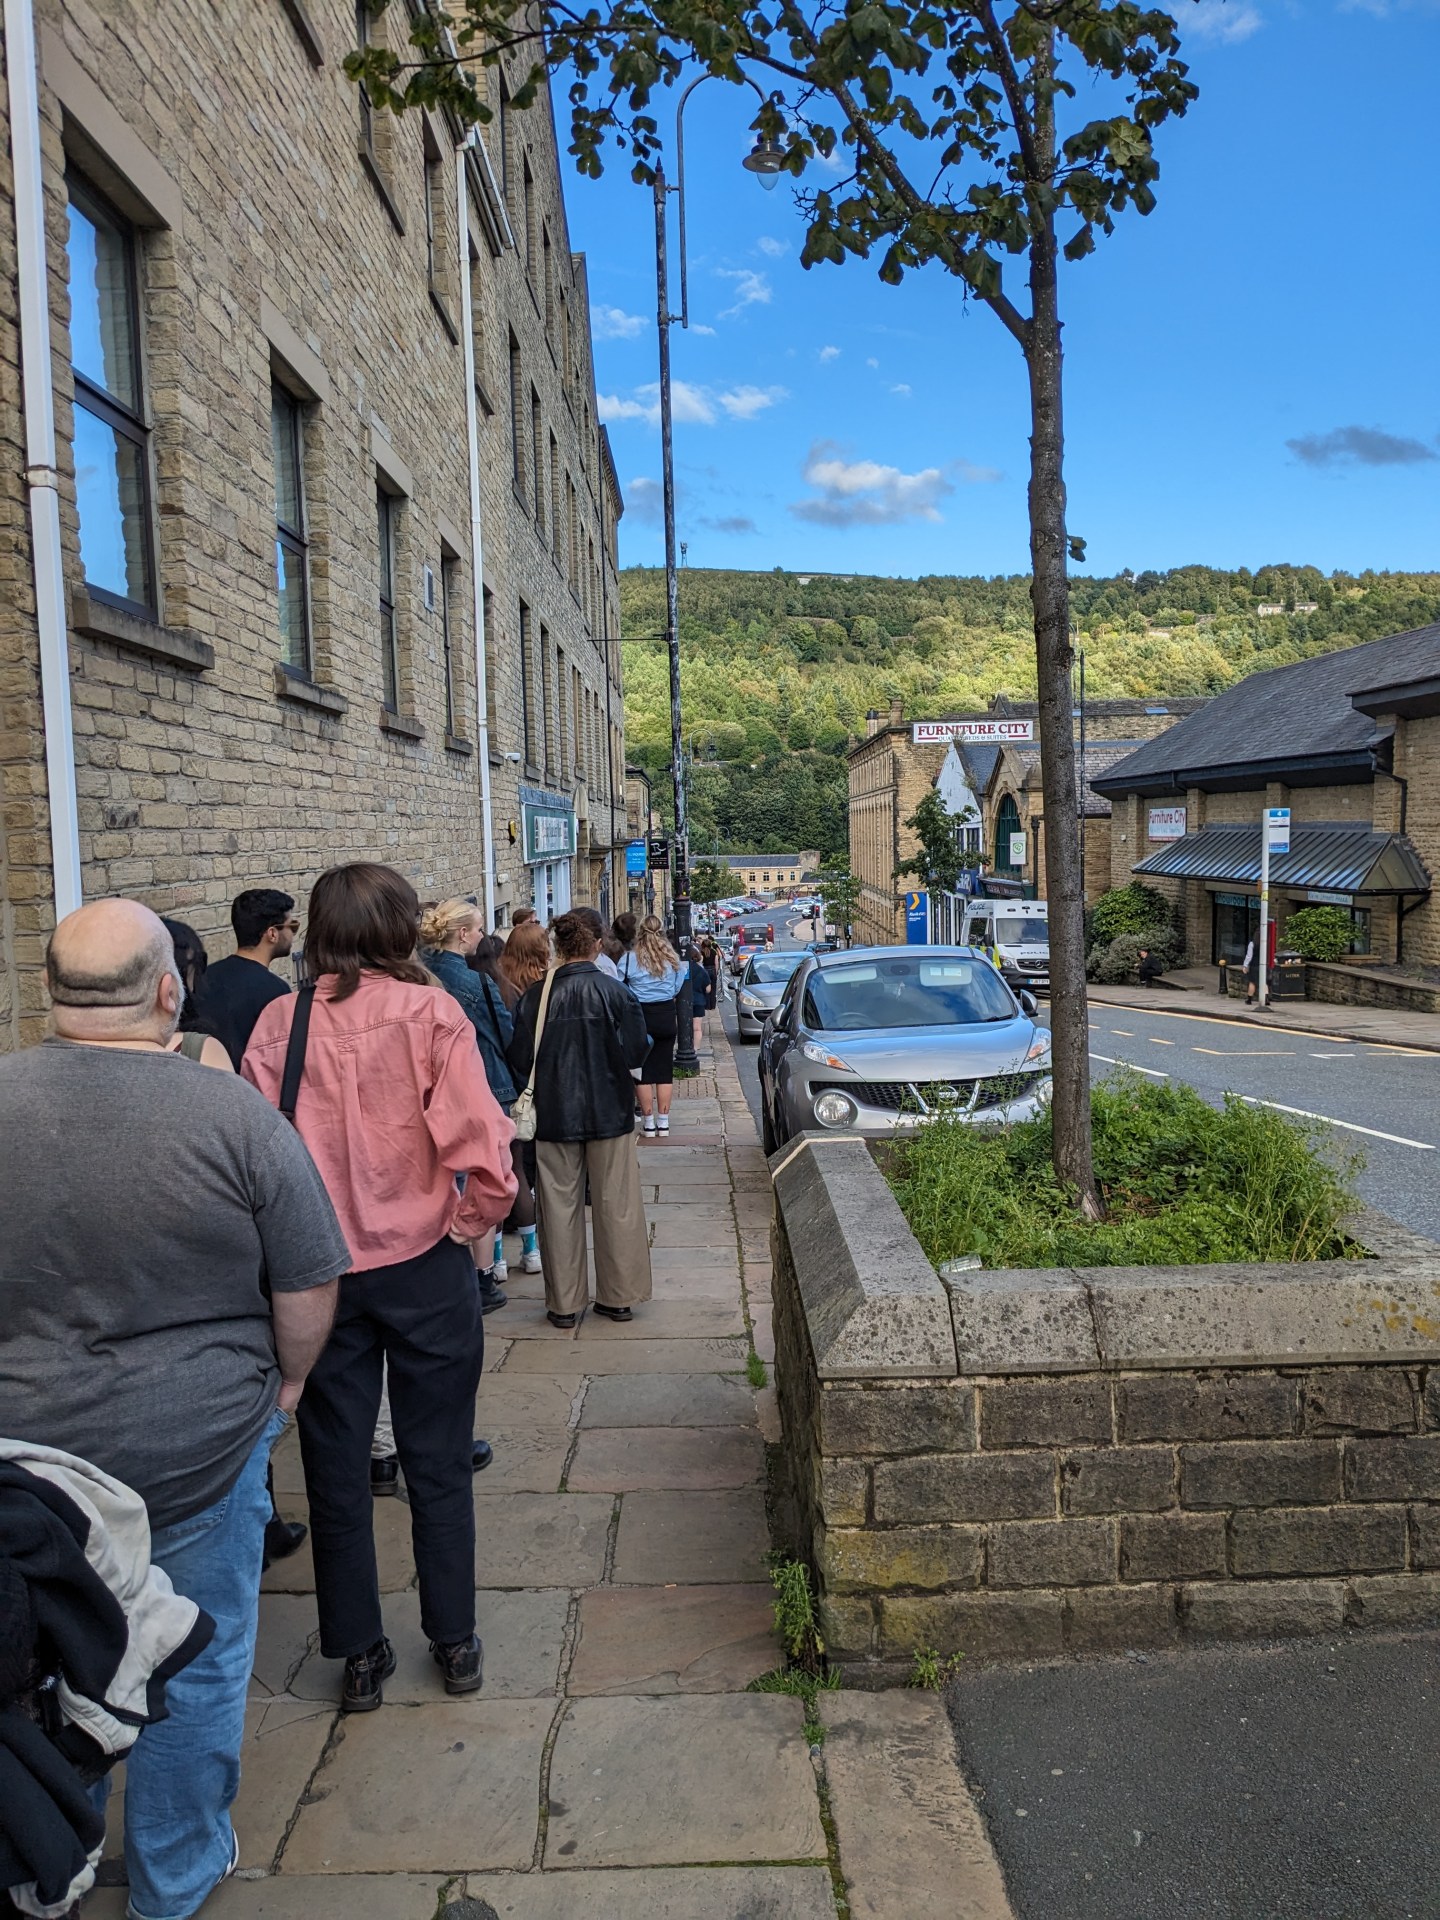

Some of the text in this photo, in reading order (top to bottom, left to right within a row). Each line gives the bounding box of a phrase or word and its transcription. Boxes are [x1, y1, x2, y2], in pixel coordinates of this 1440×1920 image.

[918, 723, 1029, 736] FURNITURE CITY
[1149, 809, 1185, 827] Furniture City
[1215, 892, 1246, 906] showroom
[968, 903, 986, 911] POLICE
